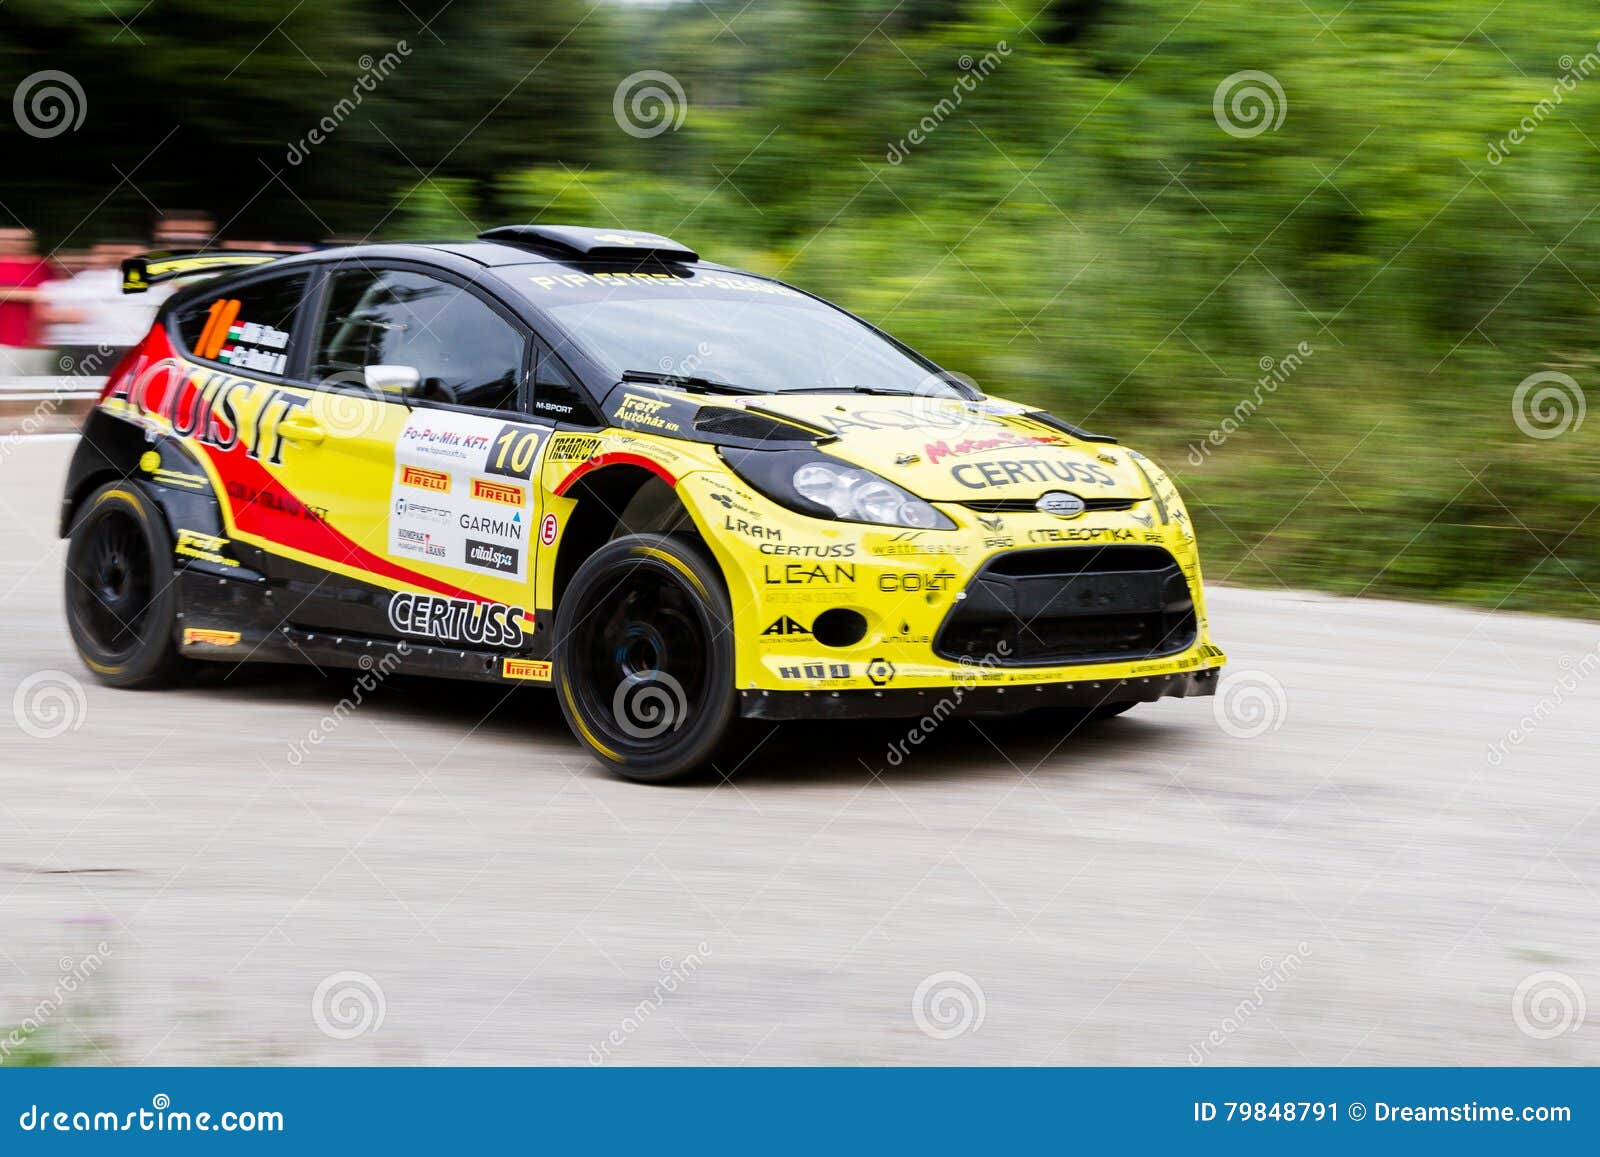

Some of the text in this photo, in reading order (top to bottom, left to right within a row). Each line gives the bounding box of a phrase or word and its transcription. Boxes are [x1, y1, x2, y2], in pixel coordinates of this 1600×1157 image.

[535, 401, 573, 414] M-SPORT
[402, 426, 490, 452] Fo-Pu-Mix KFT.
[496, 429, 540, 474] 10
[403, 466, 522, 505] PIRELLI PIRELLI
[951, 460, 1116, 490] CERTUSS
[459, 513, 522, 540] GARMIN
[759, 542, 856, 558] CERTUSS
[764, 562, 857, 585] LEAN
[878, 570, 957, 593] COLT
[388, 590, 524, 649] CERTUSS
[505, 660, 549, 678] PIRELLI
